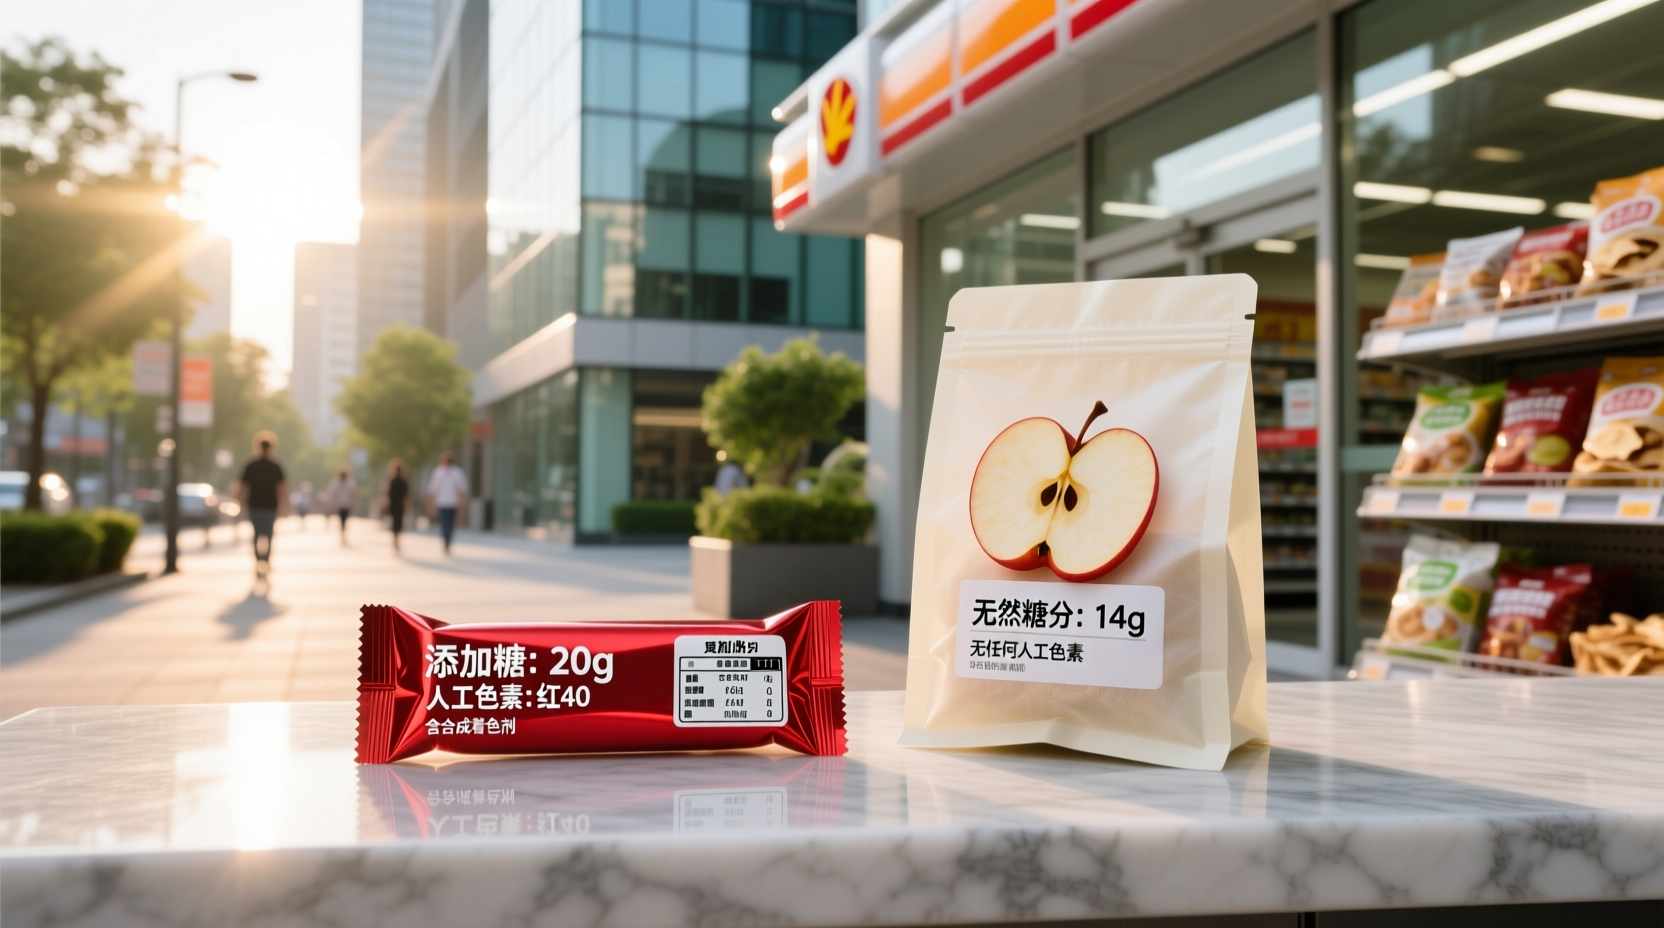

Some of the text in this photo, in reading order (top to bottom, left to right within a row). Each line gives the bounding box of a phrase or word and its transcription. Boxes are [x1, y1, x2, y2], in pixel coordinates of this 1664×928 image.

[1096, 604, 1145, 638] 14g
[425, 643, 614, 684] 添加糖: 20g
[970, 639, 1084, 663] 无任何人工色素
